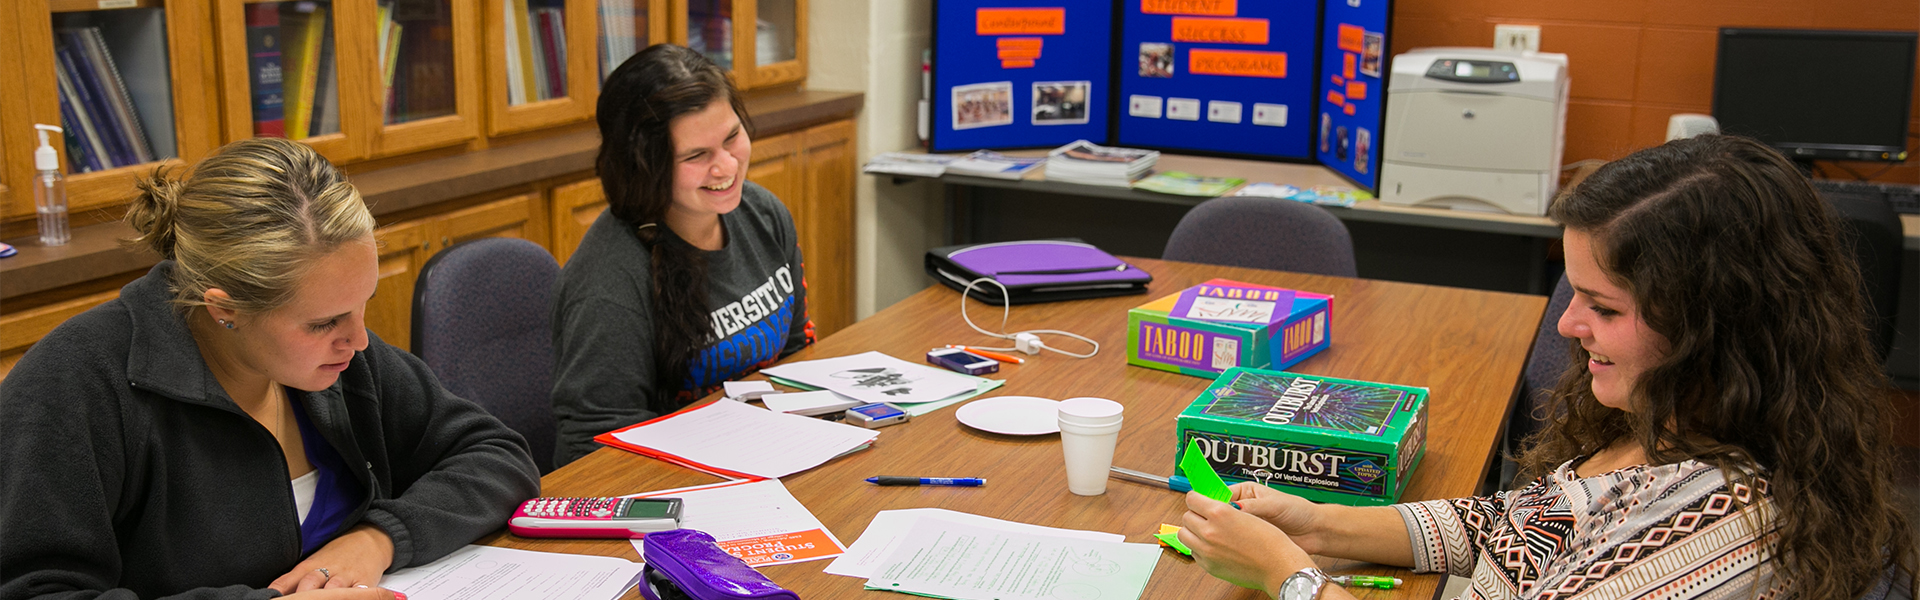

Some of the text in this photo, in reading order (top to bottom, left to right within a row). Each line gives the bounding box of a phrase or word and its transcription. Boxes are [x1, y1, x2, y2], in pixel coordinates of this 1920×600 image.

[1178, 25, 1247, 42] SUCCESS
[1195, 57, 1281, 73] PROGRAMS
[775, 263, 794, 294] O
[1198, 286, 1279, 300] TABOO
[1144, 325, 1204, 362] TABOO
[1284, 318, 1312, 355] TABOO
[1262, 377, 1320, 425] OUTBURST
[1354, 467, 1381, 475] UPDATED
[1274, 472, 1283, 480] Of
[1283, 473, 1303, 482] Verbal
[1304, 476, 1339, 487] Explosions
[747, 542, 815, 556] STUDENT
